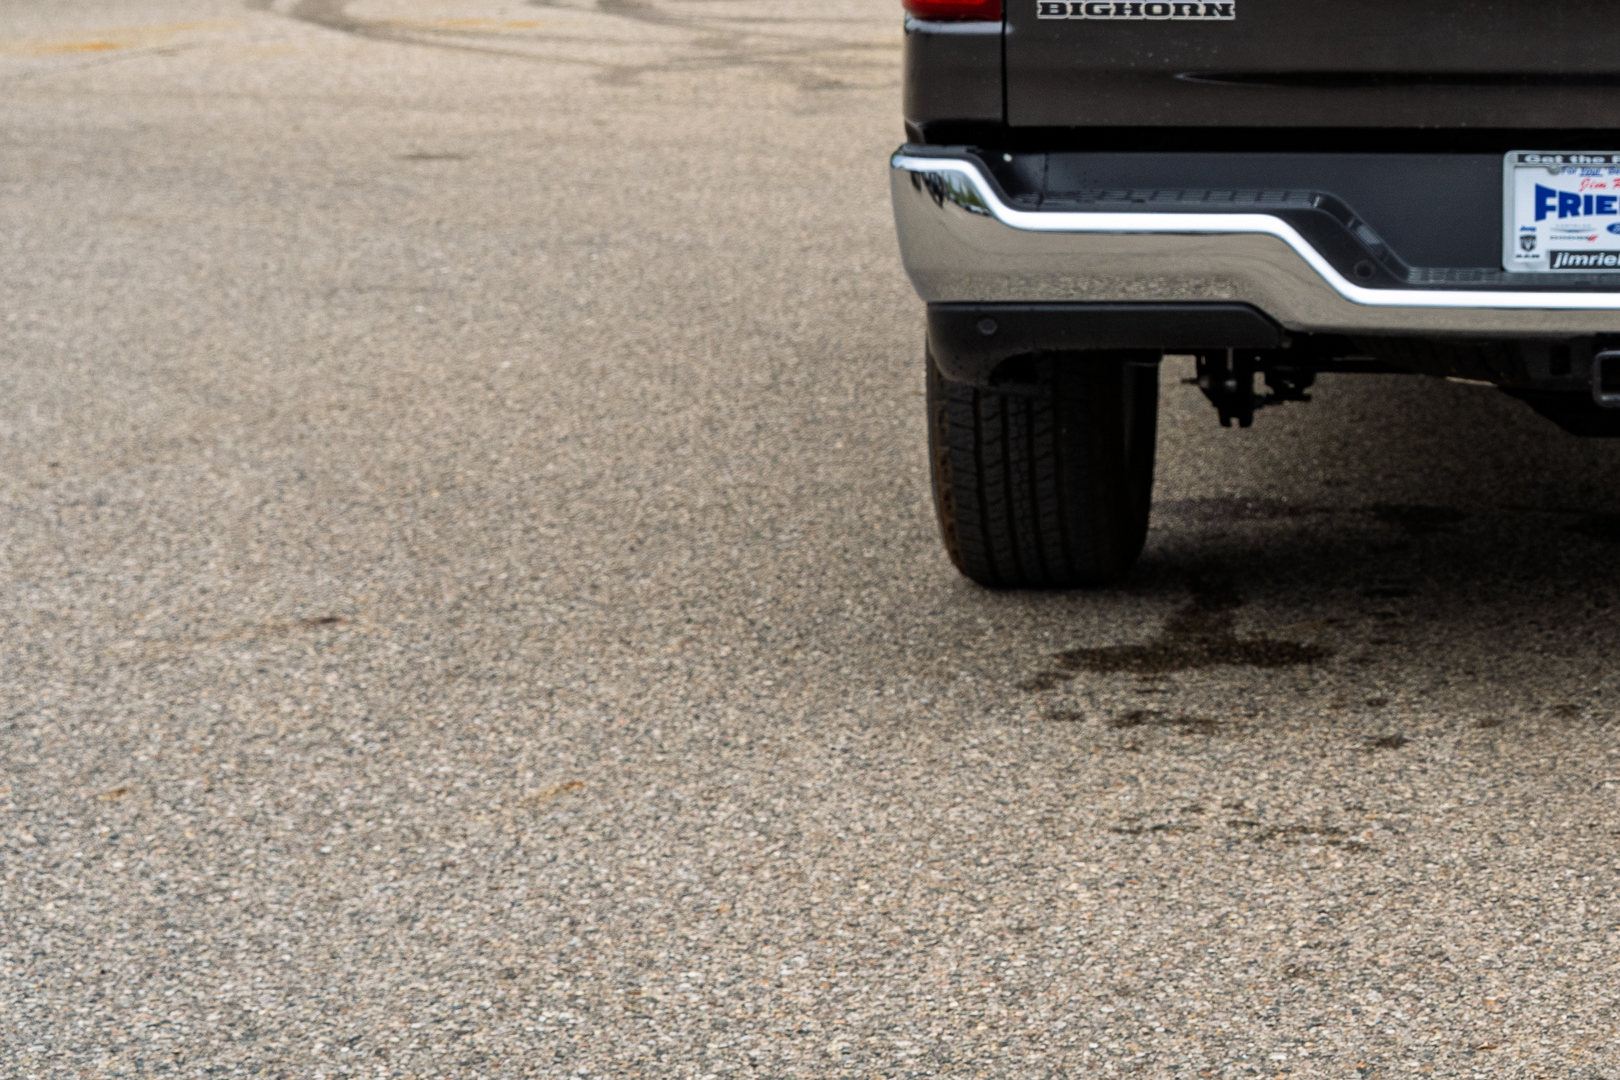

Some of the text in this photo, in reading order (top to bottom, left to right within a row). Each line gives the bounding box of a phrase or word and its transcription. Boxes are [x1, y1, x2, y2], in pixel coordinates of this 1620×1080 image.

[1524, 154, 1563, 164] Get
[1569, 154, 1605, 164] the
[1579, 177, 1607, 192] Jim
